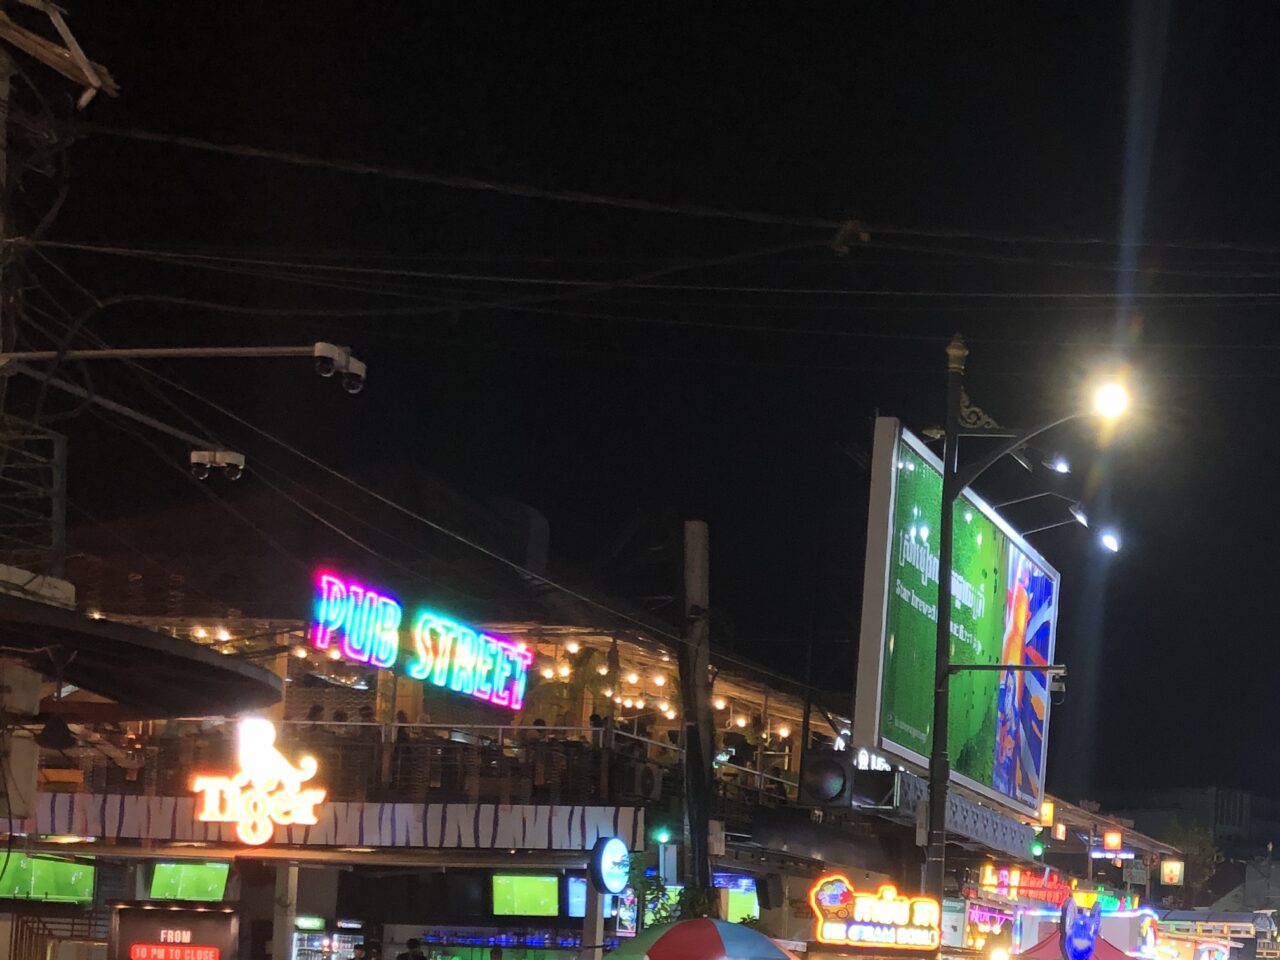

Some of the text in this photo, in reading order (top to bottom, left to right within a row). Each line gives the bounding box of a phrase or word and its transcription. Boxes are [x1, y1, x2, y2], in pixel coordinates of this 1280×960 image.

[316, 574, 533, 710] PUB STREET
[193, 773, 327, 845] Tiger
[135, 947, 215, 960] 10 PM TO CLOSE
[160, 930, 191, 943] FROM
